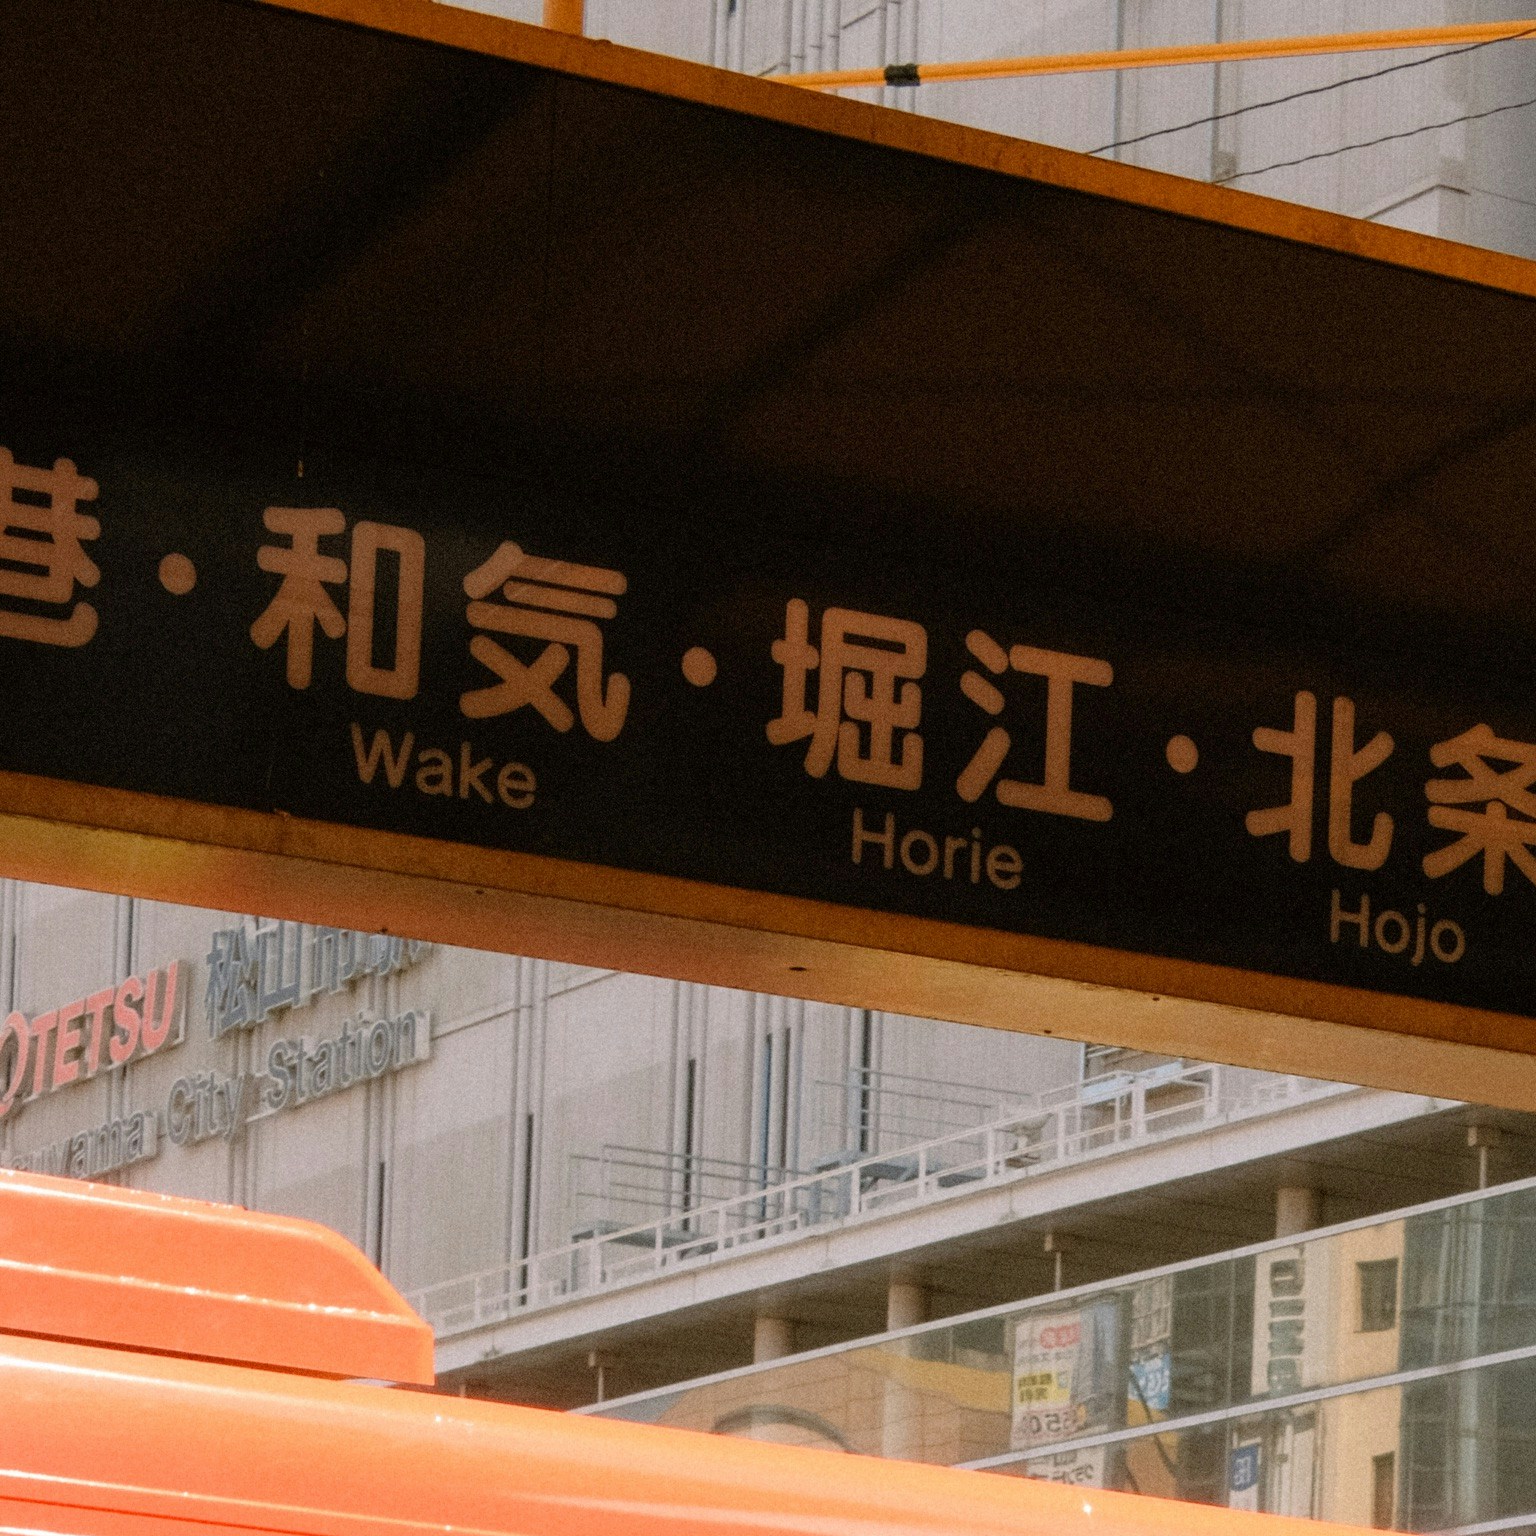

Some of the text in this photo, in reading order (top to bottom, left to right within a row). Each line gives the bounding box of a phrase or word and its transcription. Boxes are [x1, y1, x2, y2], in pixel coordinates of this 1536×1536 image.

[350, 721, 537, 809] Wake
[850, 807, 1023, 891] Horie
[1329, 888, 1467, 966] Hojo
[167, 1075, 243, 1146] City
[265, 1009, 418, 1109] Station
